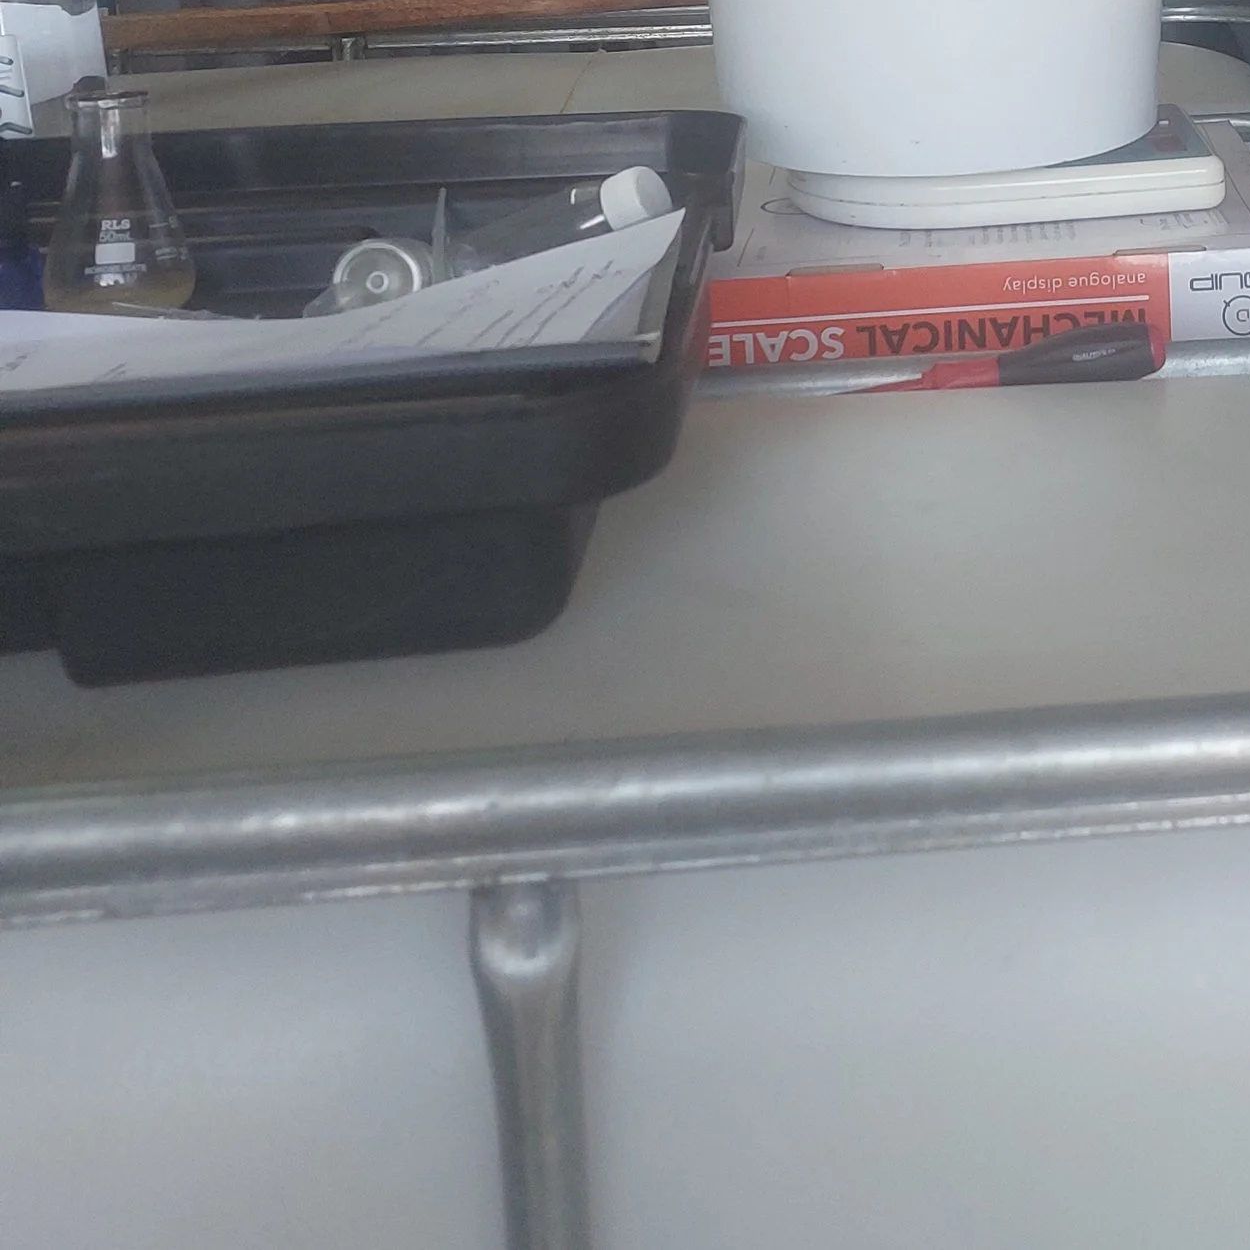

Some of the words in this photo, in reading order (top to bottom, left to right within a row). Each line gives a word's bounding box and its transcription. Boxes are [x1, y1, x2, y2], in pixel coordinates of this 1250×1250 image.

[1002, 276, 1063, 295] display
[1069, 272, 1146, 289] analogue
[708, 326, 845, 367] SCALE
